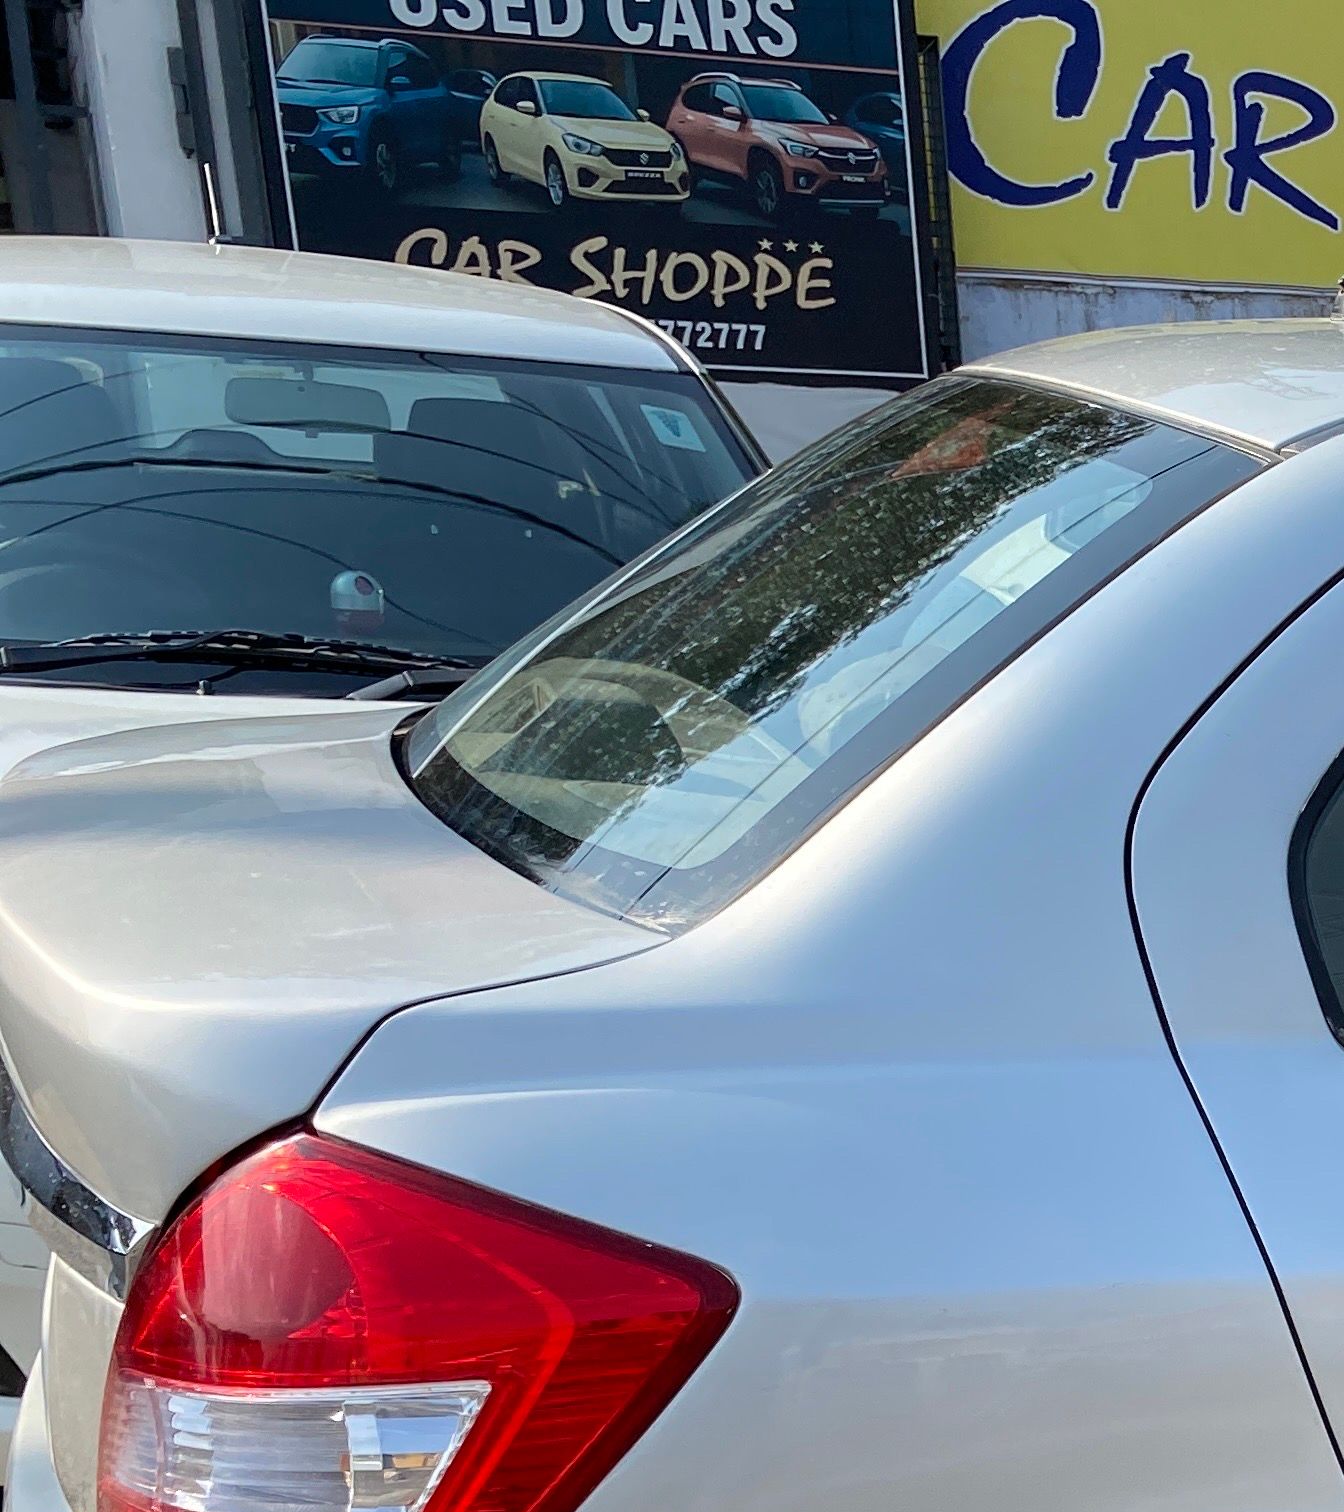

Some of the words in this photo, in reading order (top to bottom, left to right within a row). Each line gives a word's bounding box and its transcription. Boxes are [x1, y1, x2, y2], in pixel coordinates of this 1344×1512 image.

[607, 0, 797, 57] CARS
[941, 0, 1340, 232] CAR
[394, 228, 541, 286] CAR
[570, 236, 836, 310] SHOPPE
[645, 319, 766, 351] 772777
